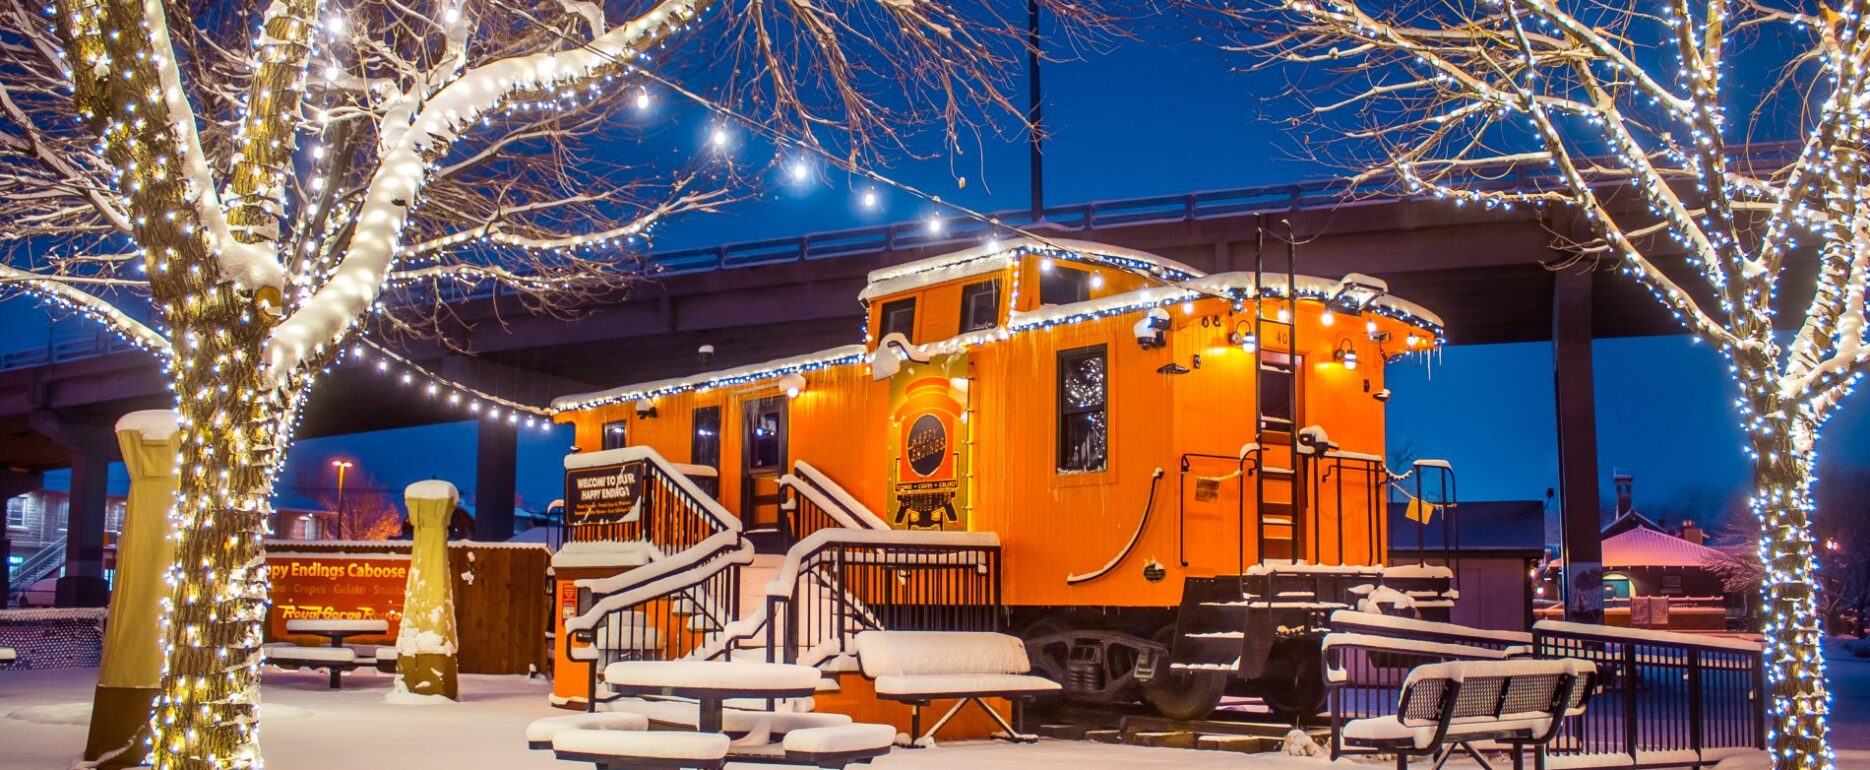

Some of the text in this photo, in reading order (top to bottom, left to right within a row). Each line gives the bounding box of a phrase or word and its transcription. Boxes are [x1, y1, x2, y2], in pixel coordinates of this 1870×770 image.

[911, 436, 945, 463] ENDINGS
[577, 476, 606, 489] WELCOME
[607, 475, 616, 487] TO
[581, 489, 601, 501] HAPPY
[265, 561, 406, 580] ppy Endings Caboose
[294, 583, 327, 597] Crepes
[333, 583, 367, 595] Gelato
[277, 605, 323, 620] Royal
[323, 606, 362, 620] Gorge
